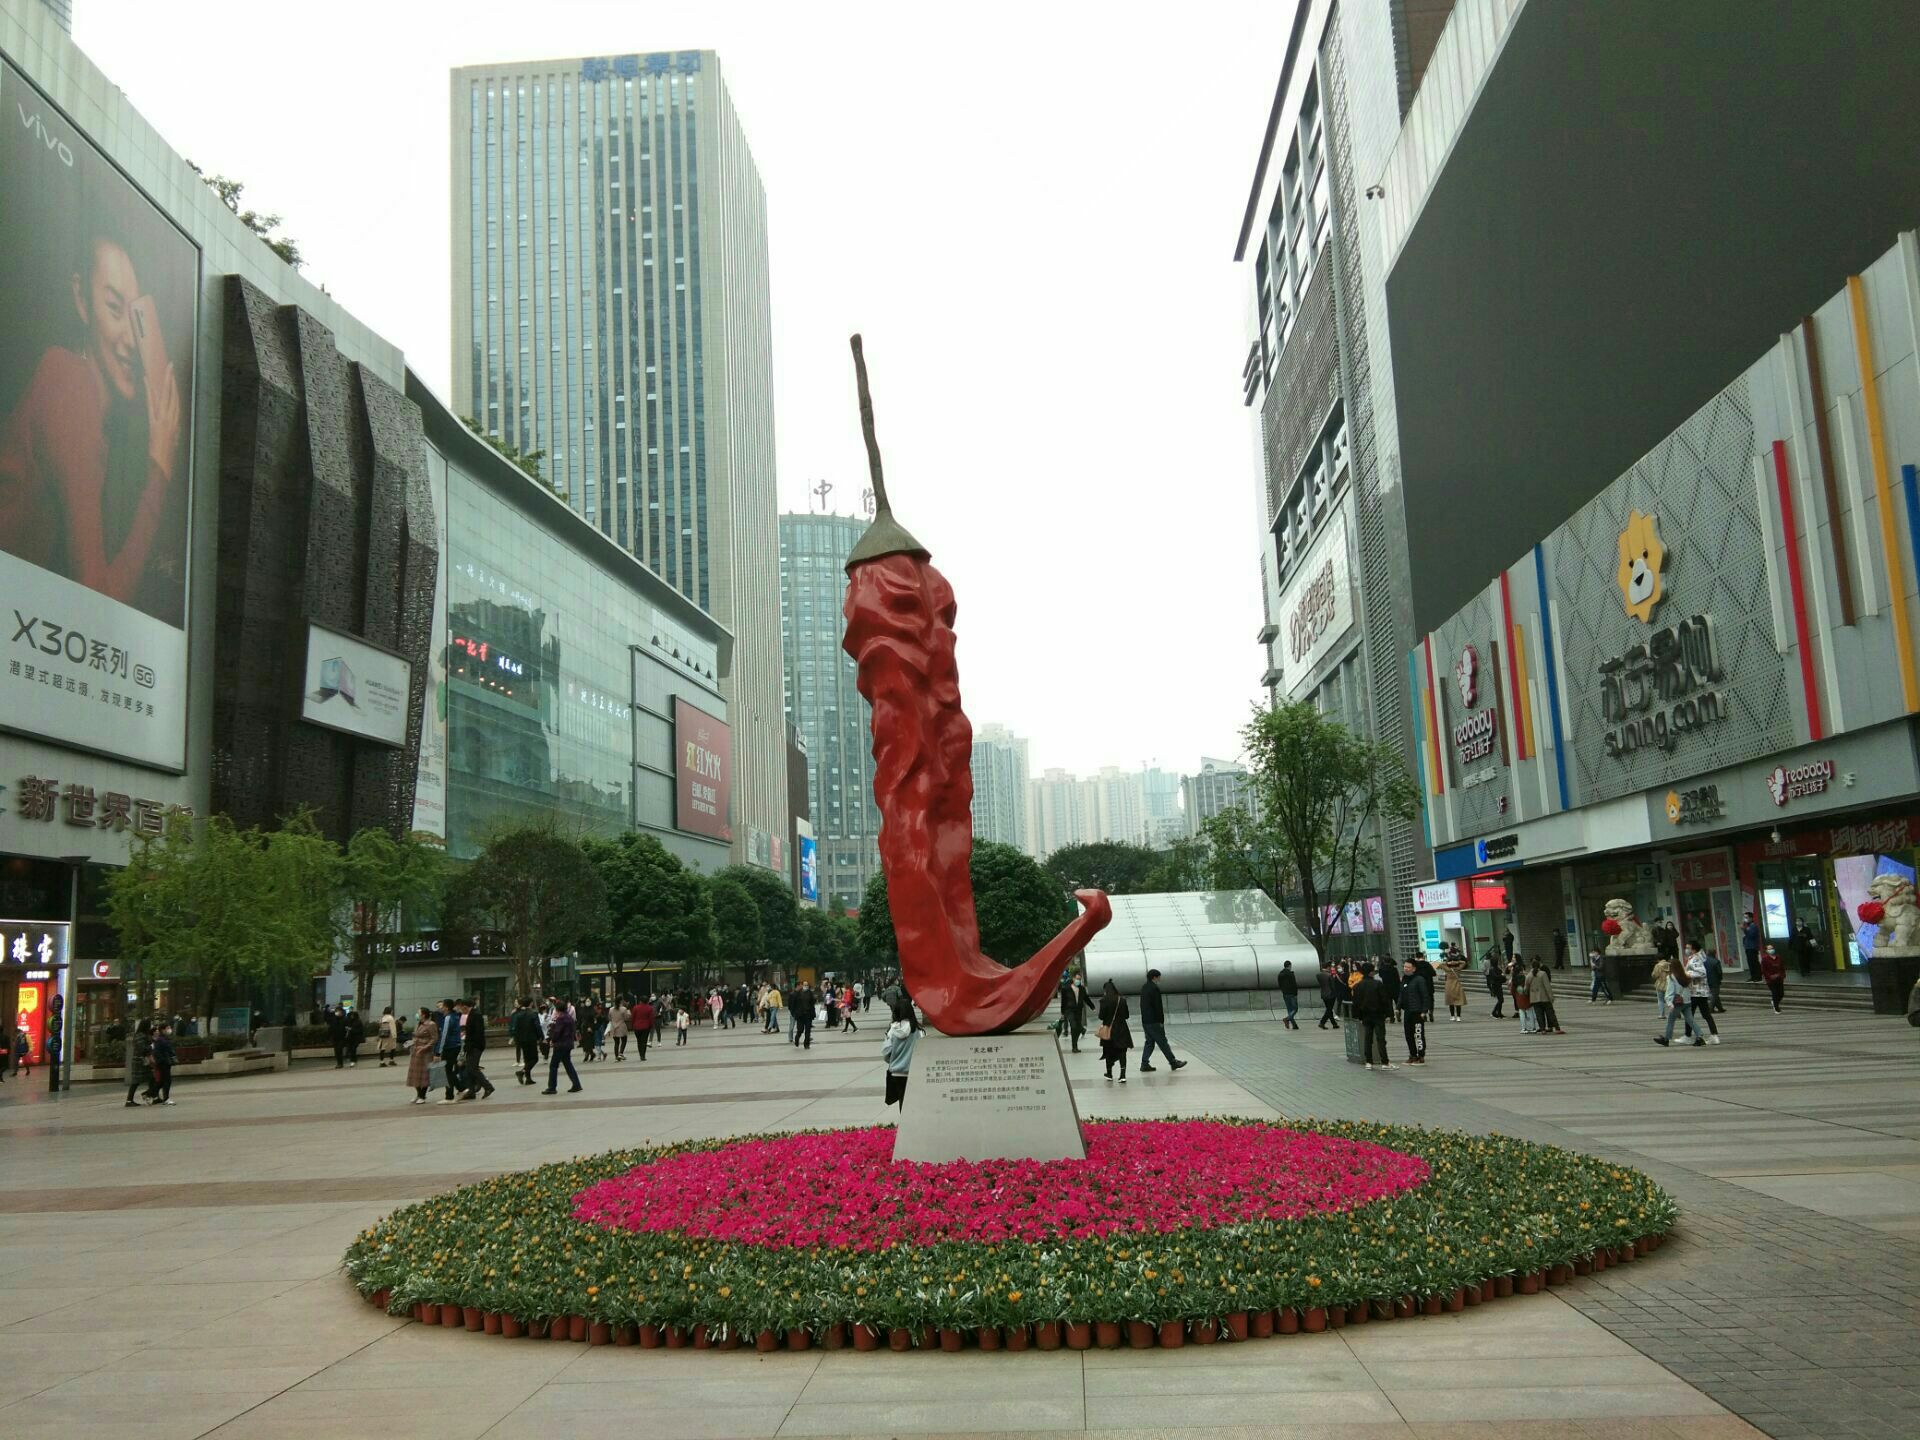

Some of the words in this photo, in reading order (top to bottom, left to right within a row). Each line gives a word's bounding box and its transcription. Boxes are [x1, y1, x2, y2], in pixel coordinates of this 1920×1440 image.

[17, 101, 75, 168] vivo
[11, 609, 129, 680] X30系列
[136, 669, 153, 685] 5G
[1598, 613, 1720, 723] 苏宁易购
[1453, 707, 1493, 746] redbaby
[1605, 691, 1726, 758] suning.com
[1785, 760, 1832, 784] redbaby
[1788, 779, 1826, 798] 苏宁红孩子
